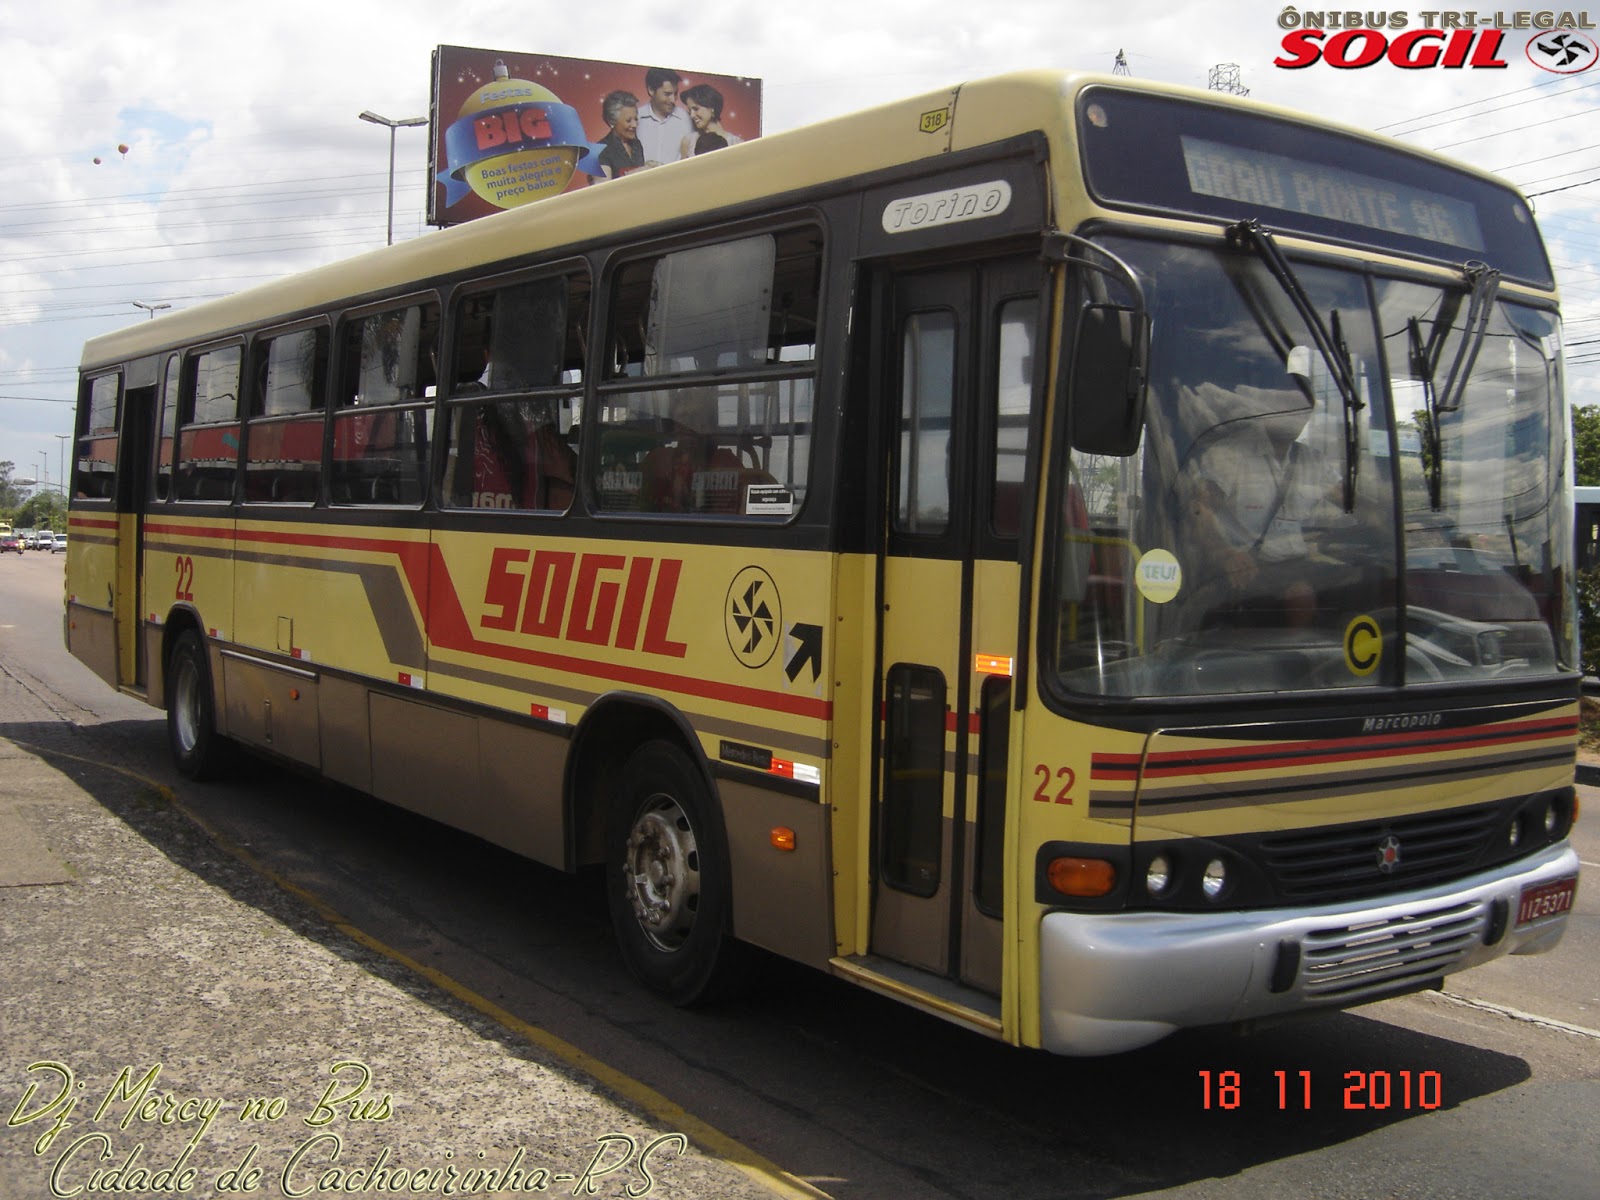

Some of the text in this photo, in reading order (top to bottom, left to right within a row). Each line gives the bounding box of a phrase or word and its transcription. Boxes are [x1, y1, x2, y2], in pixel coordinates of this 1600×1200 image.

[480, 88, 532, 104] Festas
[474, 108, 553, 151] BIG
[924, 113, 942, 128] 318
[481, 155, 561, 179] Boas festas com
[487, 166, 562, 189] muita alegria e
[496, 179, 558, 200] preço baixo.
[894, 189, 1001, 228] Torino
[175, 555, 193, 601] 22
[481, 547, 688, 659] SOGIL
[1348, 621, 1378, 669] C
[1362, 712, 1441, 731] Marcopolo
[1033, 764, 1075, 805] 22
